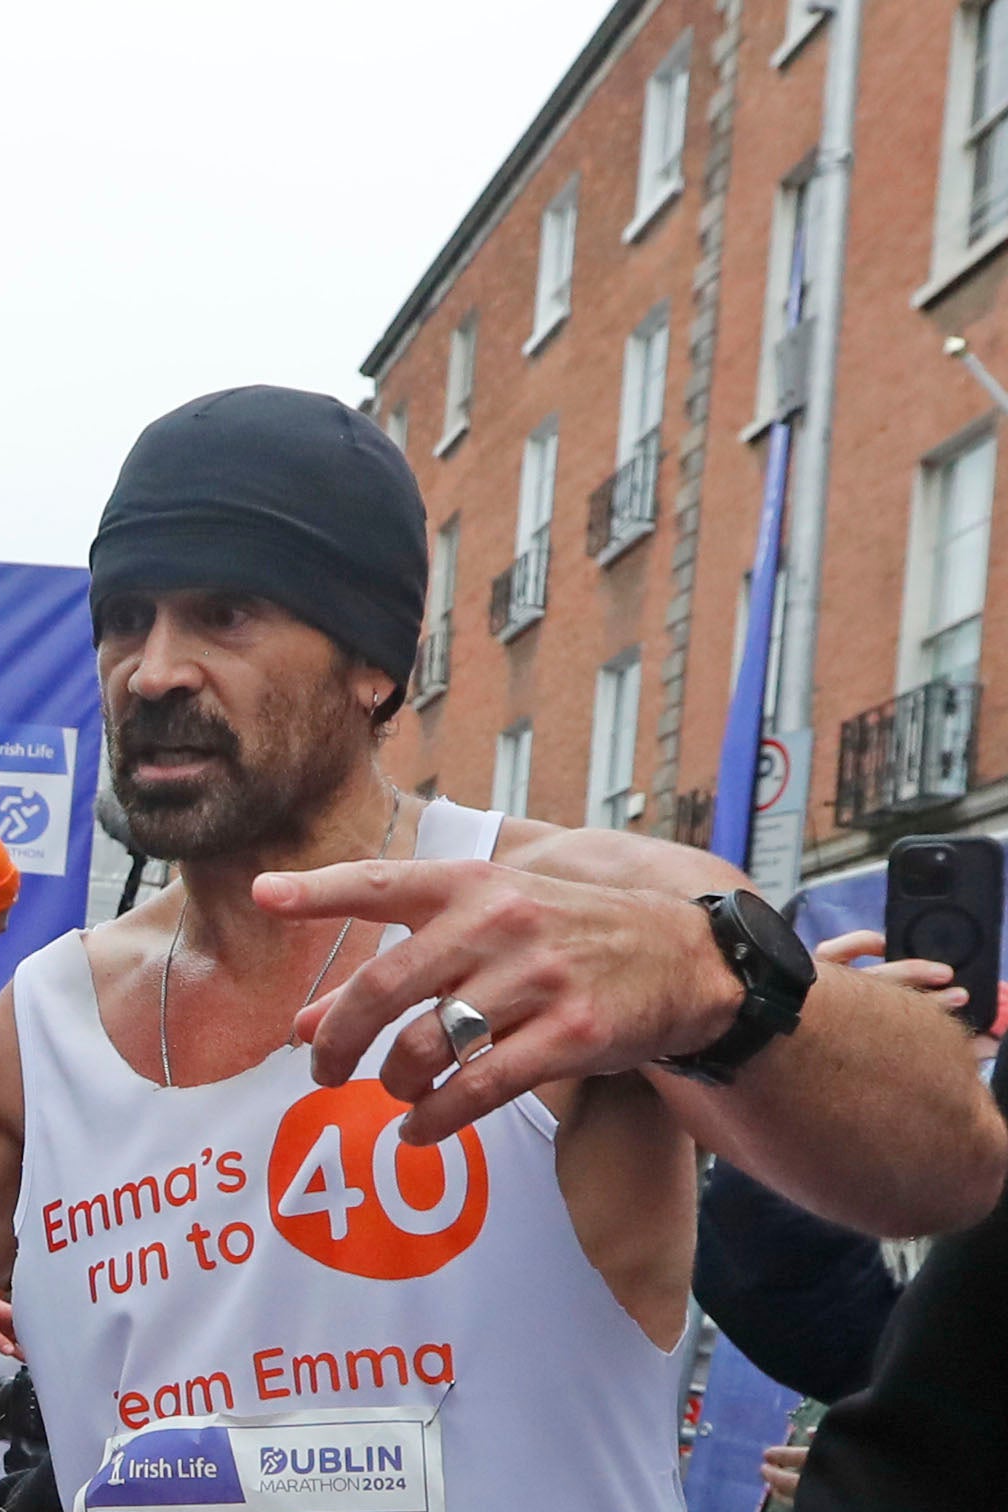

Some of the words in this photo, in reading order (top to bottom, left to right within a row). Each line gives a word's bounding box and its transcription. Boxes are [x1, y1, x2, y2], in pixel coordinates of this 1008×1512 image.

[27, 743, 54, 759] Life
[8, 848, 45, 859] THON
[43, 1147, 248, 1254] Emma's
[277, 1113, 470, 1242] 40
[87, 1241, 169, 1304] run
[186, 1220, 256, 1271] to
[113, 1371, 234, 1430] eam
[252, 1342, 455, 1401] Emma
[129, 1458, 172, 1480] Irish
[177, 1457, 218, 1479] Life
